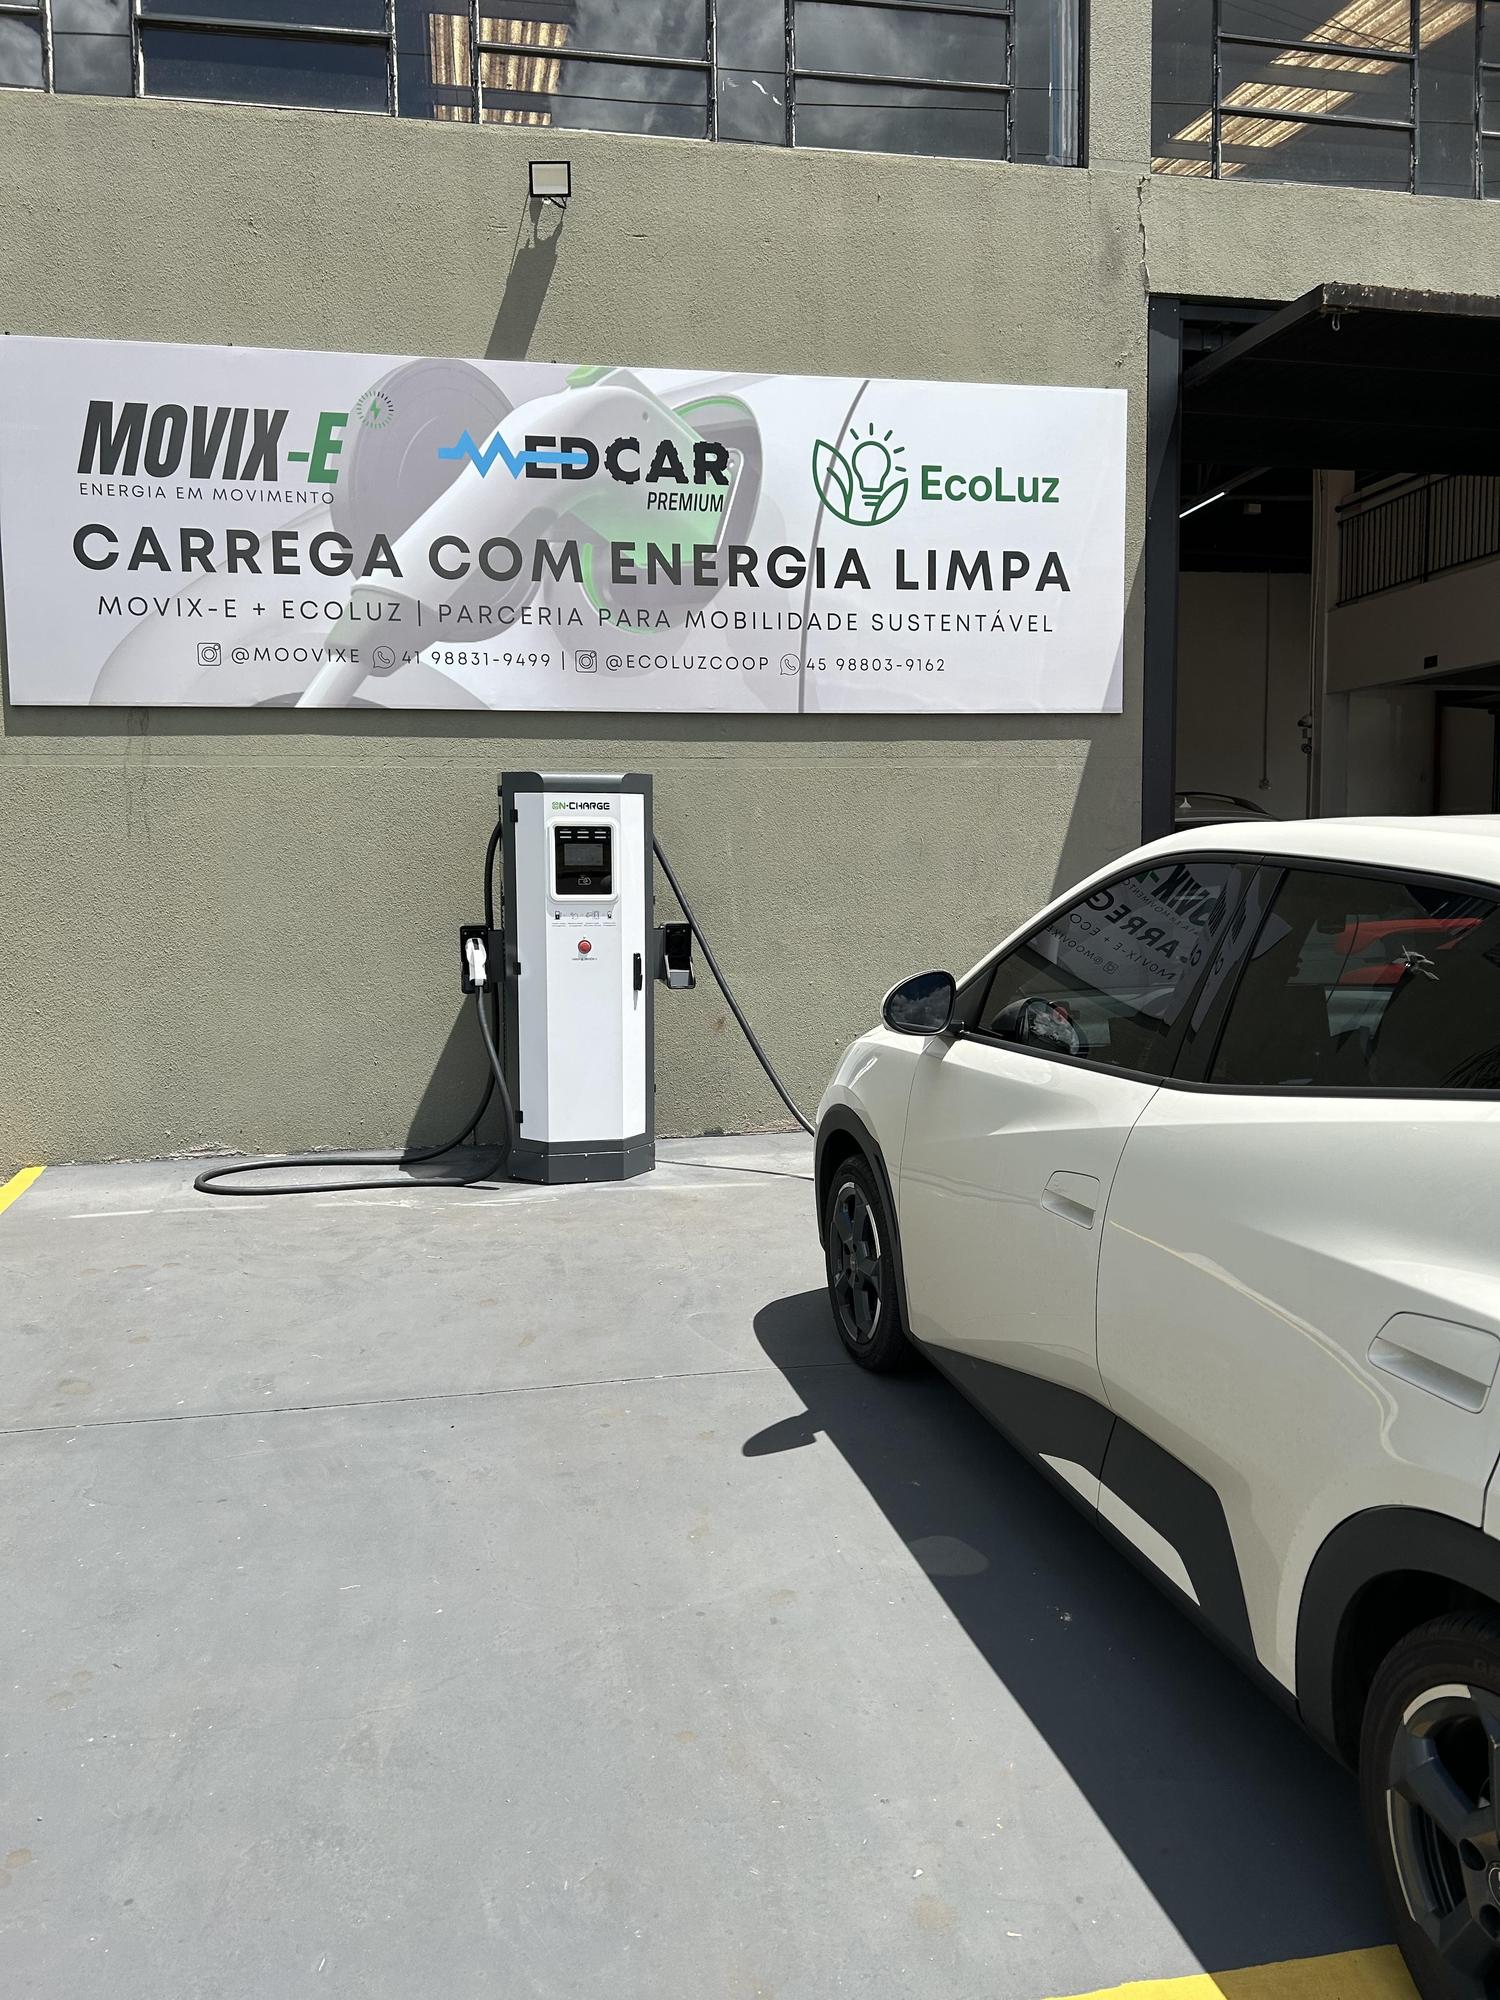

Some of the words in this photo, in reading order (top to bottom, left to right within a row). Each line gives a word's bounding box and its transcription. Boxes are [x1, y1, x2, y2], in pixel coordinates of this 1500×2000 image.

[77, 400, 349, 484] MOVIX-E
[79, 482, 166, 499] ENERGIA
[177, 487, 203, 500] EM
[213, 488, 335, 504] MOVIMENTO
[647, 492, 723, 512] PREMIUM
[921, 465, 1059, 503] EcoLuz
[73, 523, 403, 577] CARREGA
[428, 535, 584, 583] COM
[611, 541, 871, 590] ENERGIA
[897, 549, 1070, 592] LIMPA
[98, 596, 236, 618] MOVIX-E
[283, 600, 402, 622] ECOLUZ
[439, 603, 583, 627] PARCERIA
[599, 608, 671, 629] PARA
[685, 610, 858, 632] MOBILIDADE
[871, 609, 1053, 633] SUSTENTÁVEL
[231, 646, 359, 664] @MOOVIXE
[402, 650, 421, 665] 41
[431, 651, 551, 667] 98831-9499
[606, 654, 769, 672] @ECOLUZCOOP
[806, 658, 827, 672] 45
[836, 658, 945, 673] 98803-9162
